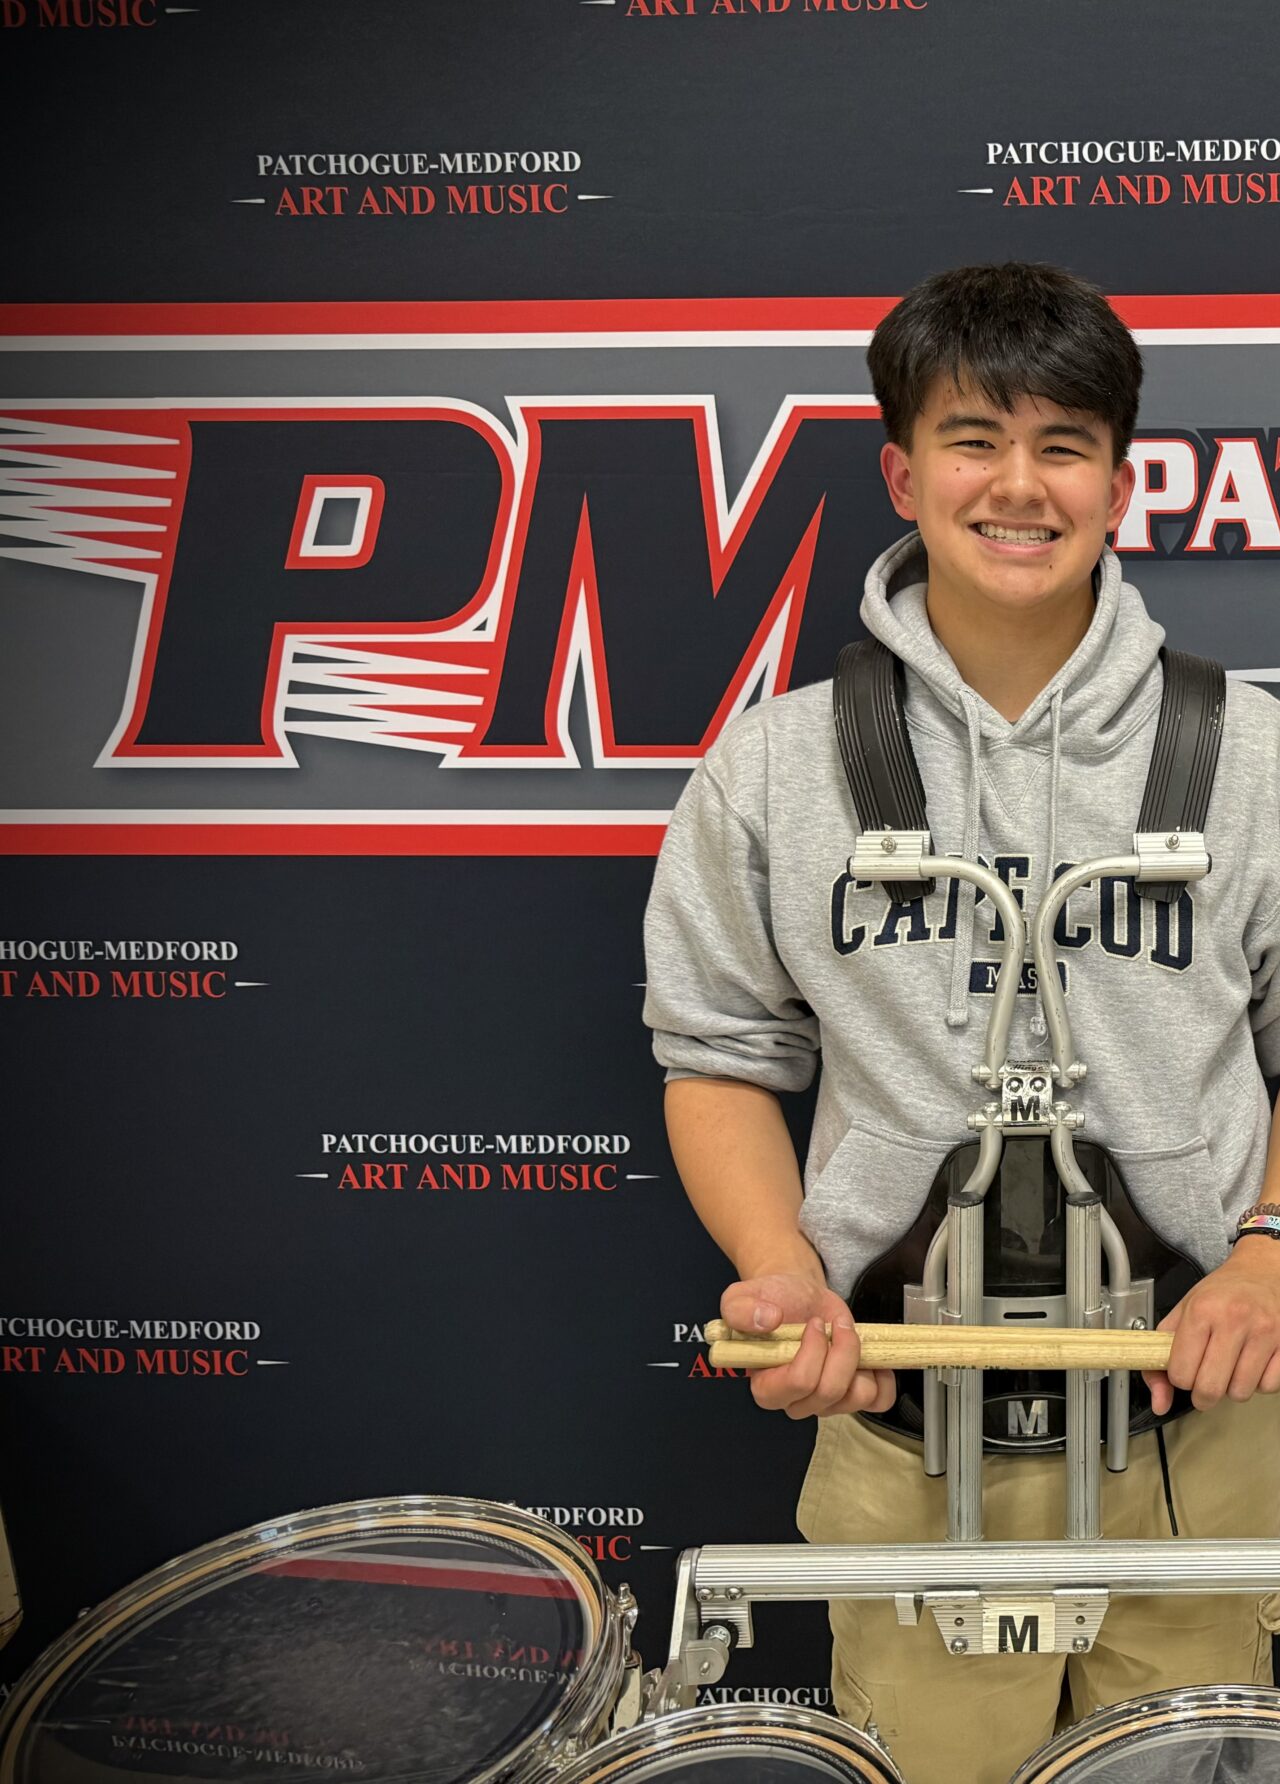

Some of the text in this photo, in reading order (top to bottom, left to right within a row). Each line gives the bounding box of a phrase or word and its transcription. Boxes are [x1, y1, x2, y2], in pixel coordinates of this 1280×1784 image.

[38, 0, 157, 29] MUSIC
[257, 150, 581, 176] PATCHOGUE-MEDFORD
[275, 183, 569, 217] ART AND MUSIC
[1003, 175, 1081, 207] ART
[1090, 174, 1172, 206] AND
[0, 940, 239, 961] HOGUE-MEDFORD
[26, 970, 101, 998] AND
[110, 970, 226, 999] MUSIC
[322, 1133, 631, 1155] PATCHOGUE-MEDFORD
[338, 1162, 617, 1192] ART AND MUSIC
[0, 1317, 261, 1341] TCHOGUE-MEDFORD
[54, 1347, 126, 1374] AND
[134, 1348, 248, 1377] MUSIC
[1008, 1400, 1048, 1434] M
[999, 1615, 1038, 1653] M
